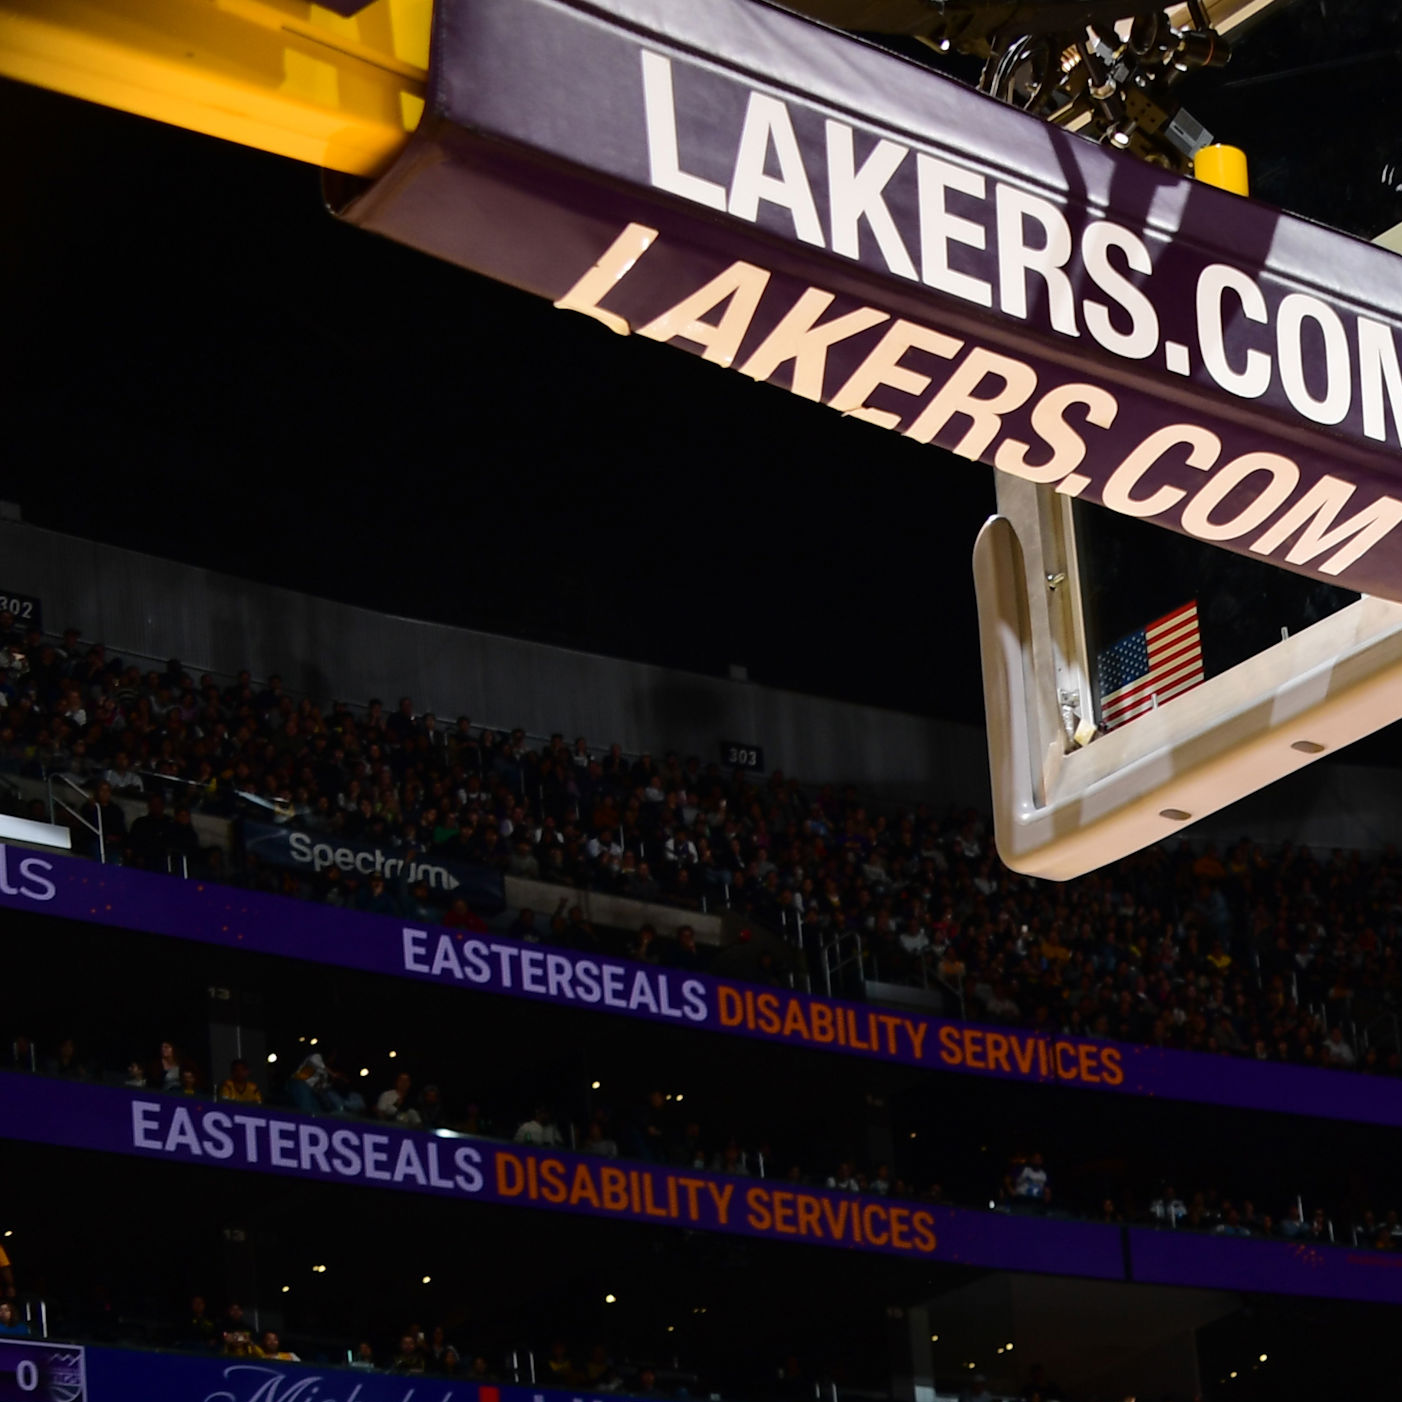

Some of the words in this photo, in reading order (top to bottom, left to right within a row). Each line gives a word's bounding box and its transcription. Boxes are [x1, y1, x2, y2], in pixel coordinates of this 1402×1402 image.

[728, 747, 758, 767] 303
[288, 831, 451, 890] Spectrum
[402, 926, 707, 1022] EASTERSEALS
[717, 984, 928, 1061] DISABILITY
[938, 1025, 1124, 1087] SERVICES
[131, 1099, 484, 1193] EASTERSEALS
[495, 1151, 734, 1226] DISABILITY
[746, 1186, 937, 1253] SERVICES
[16, 1359, 40, 1392] 0
